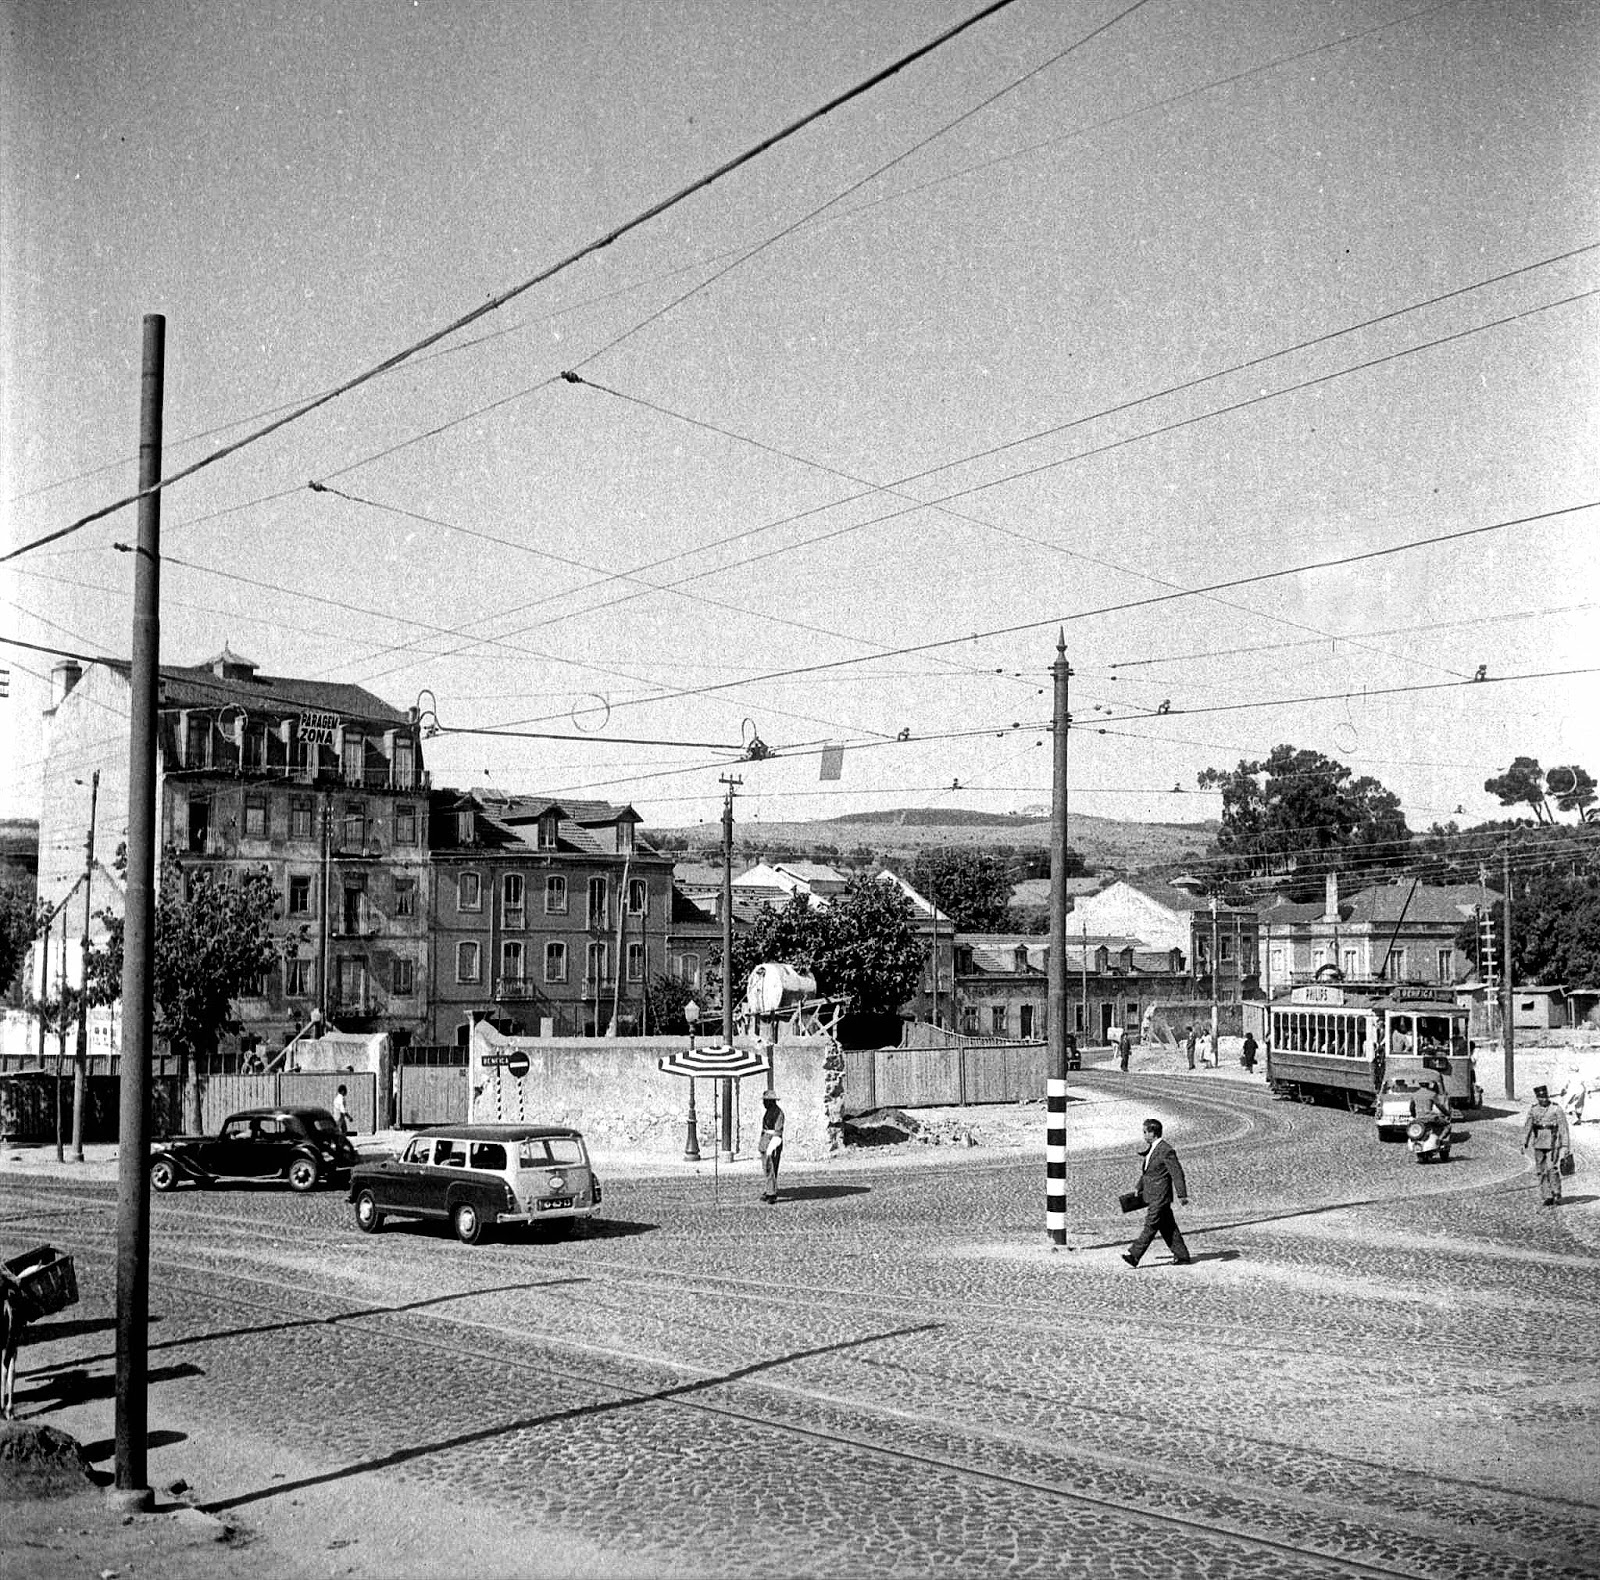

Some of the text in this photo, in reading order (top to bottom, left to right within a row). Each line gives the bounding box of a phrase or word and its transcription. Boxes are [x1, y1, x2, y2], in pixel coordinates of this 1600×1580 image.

[301, 713, 339, 730] PARAGEM
[300, 728, 333, 744] ZONA
[1305, 988, 1328, 1001] PHILIPS
